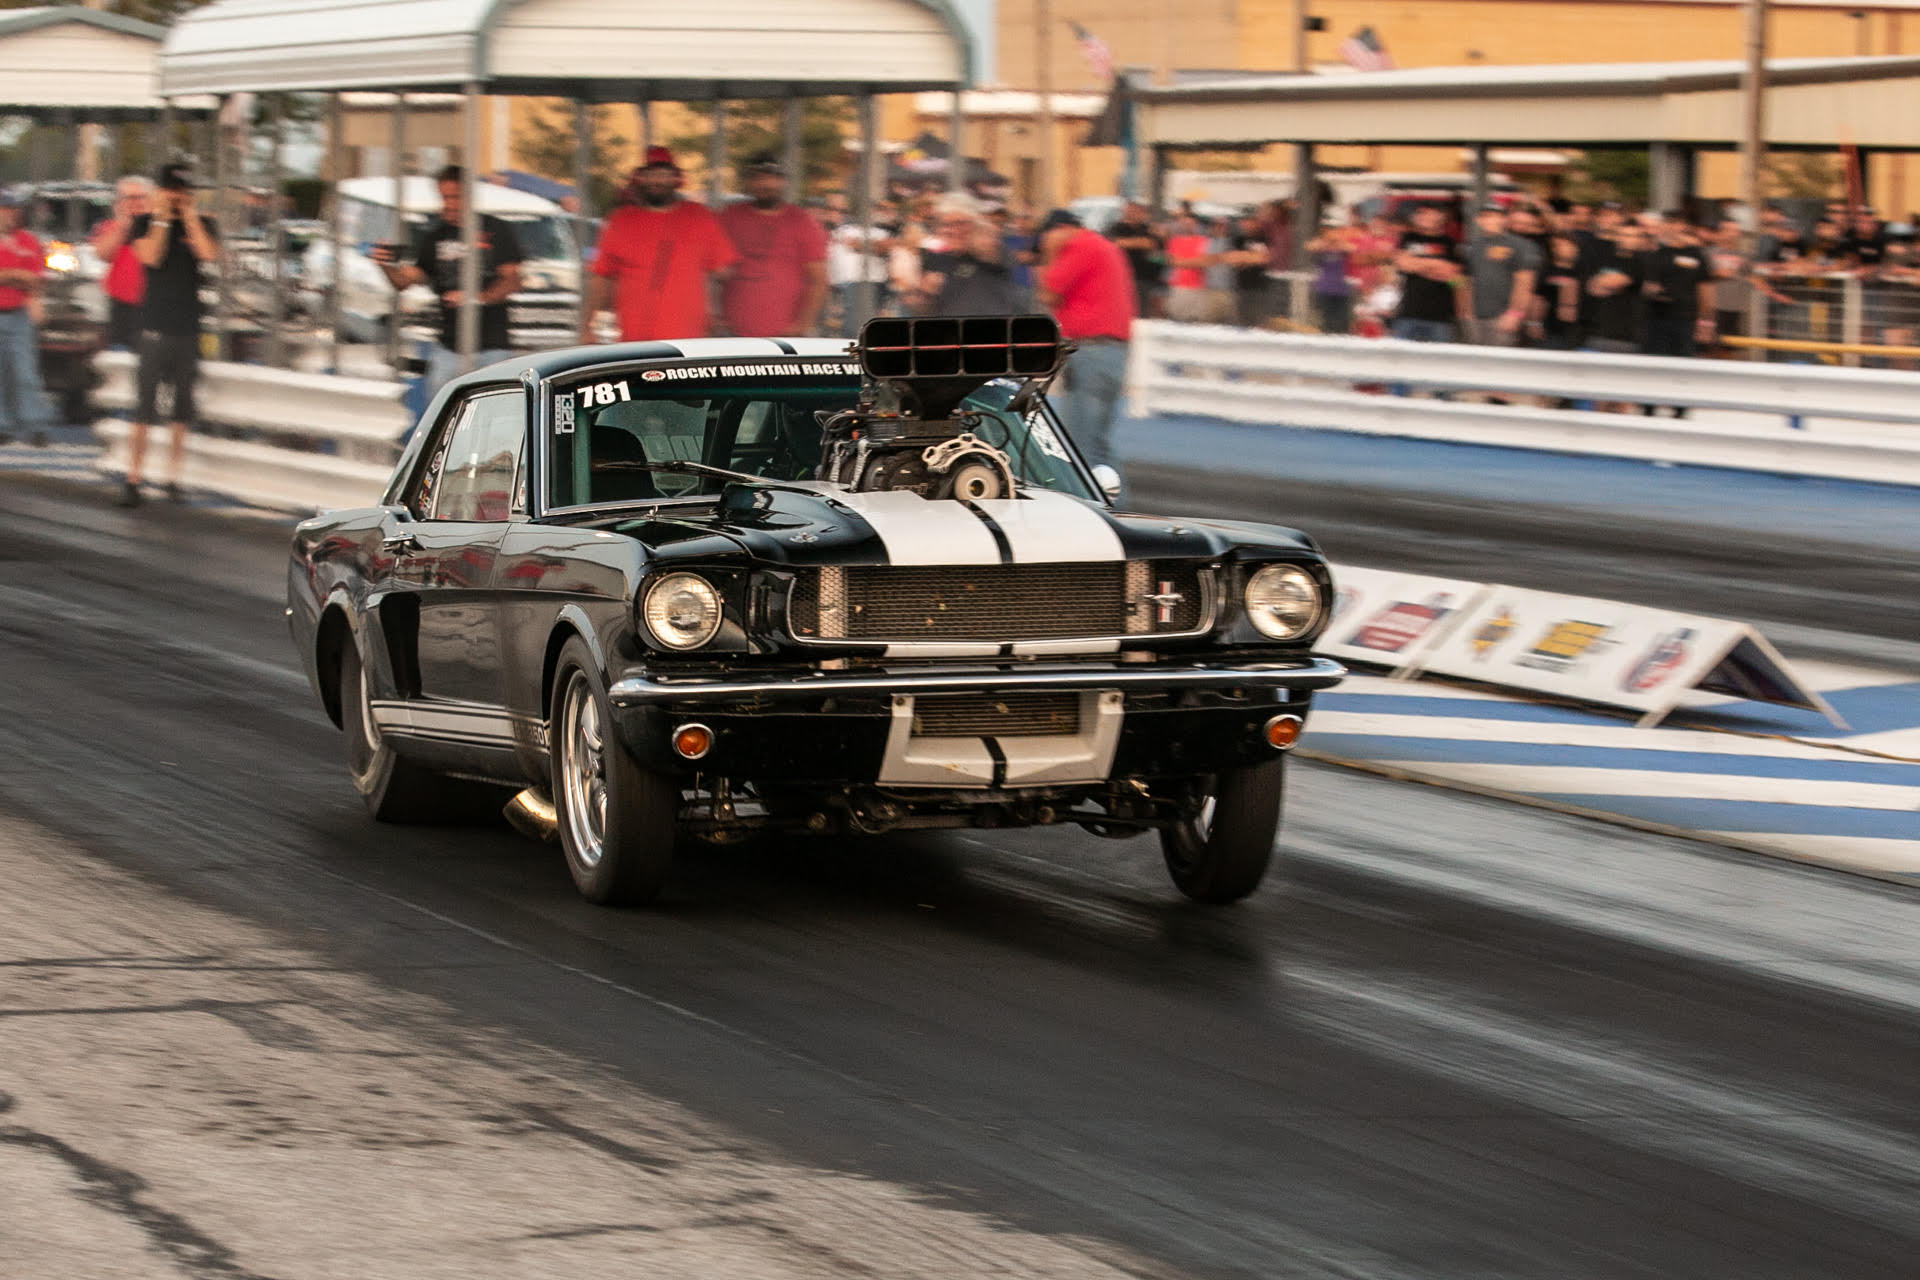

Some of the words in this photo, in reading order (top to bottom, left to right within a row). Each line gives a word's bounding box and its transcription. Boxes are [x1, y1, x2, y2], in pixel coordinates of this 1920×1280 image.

[666, 366, 718, 380] ROCKY
[720, 363, 801, 377] MOUNTAIN
[802, 363, 843, 375] RACE
[577, 381, 631, 408] 781
[561, 392, 575, 433] 1320
